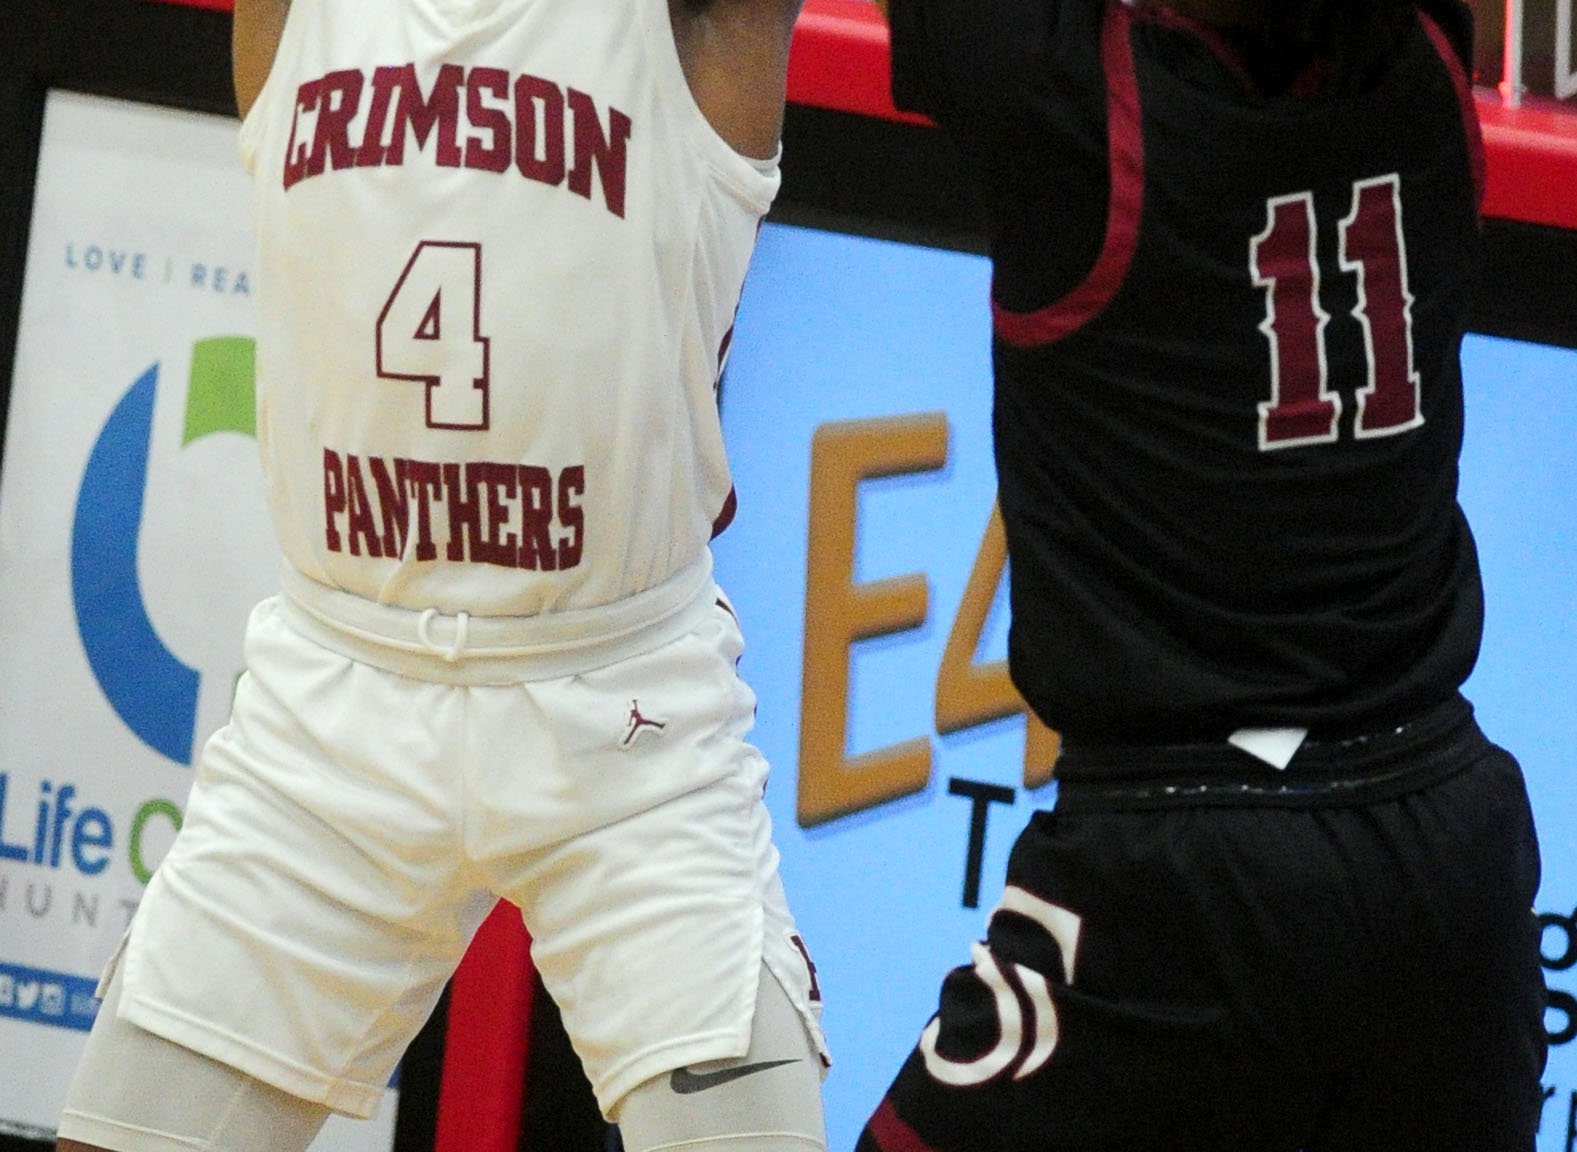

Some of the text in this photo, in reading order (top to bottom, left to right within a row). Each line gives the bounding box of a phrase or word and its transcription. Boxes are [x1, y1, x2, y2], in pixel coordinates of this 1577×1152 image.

[283, 62, 632, 221] CRIMSON
[64, 243, 251, 296] LOVE REA
[376, 239, 490, 432] 4
[1248, 172, 1425, 452] 11
[324, 446, 586, 573] PANTHERS
